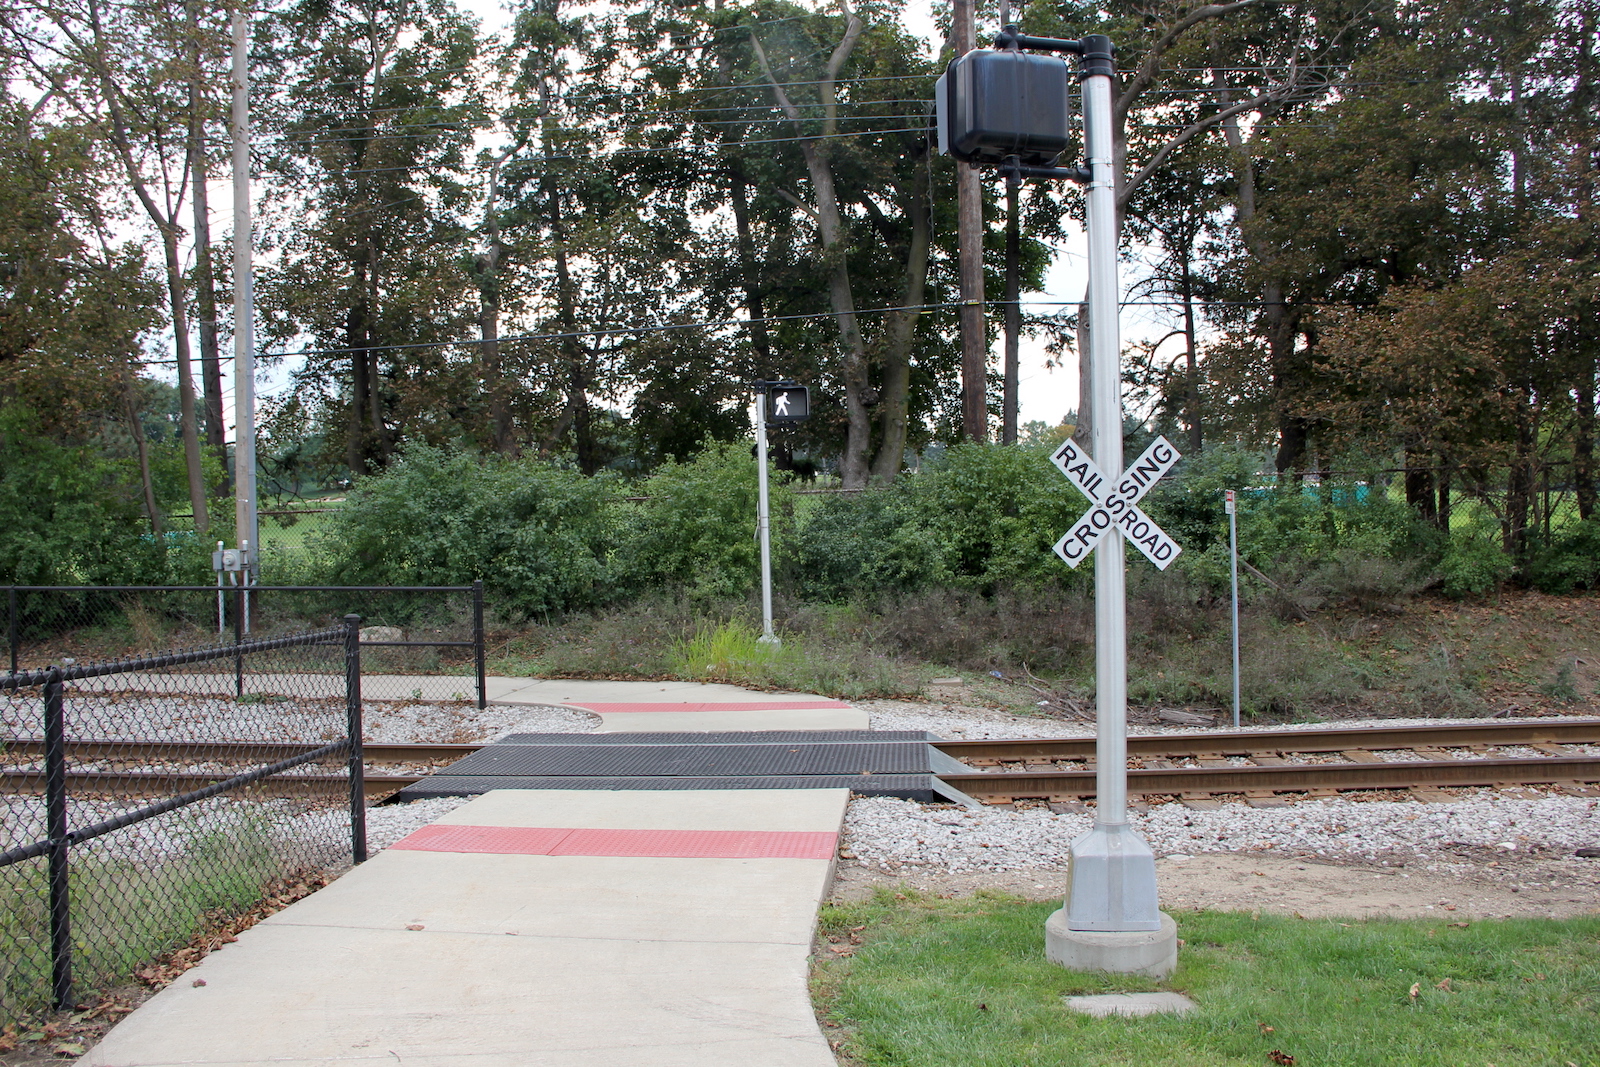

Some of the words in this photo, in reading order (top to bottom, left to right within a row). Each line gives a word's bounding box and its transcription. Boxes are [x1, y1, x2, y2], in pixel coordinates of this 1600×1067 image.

[1056, 445, 1103, 500] RAIL
[1118, 509, 1172, 561] ROAD
[1062, 444, 1173, 559] CROSSING
